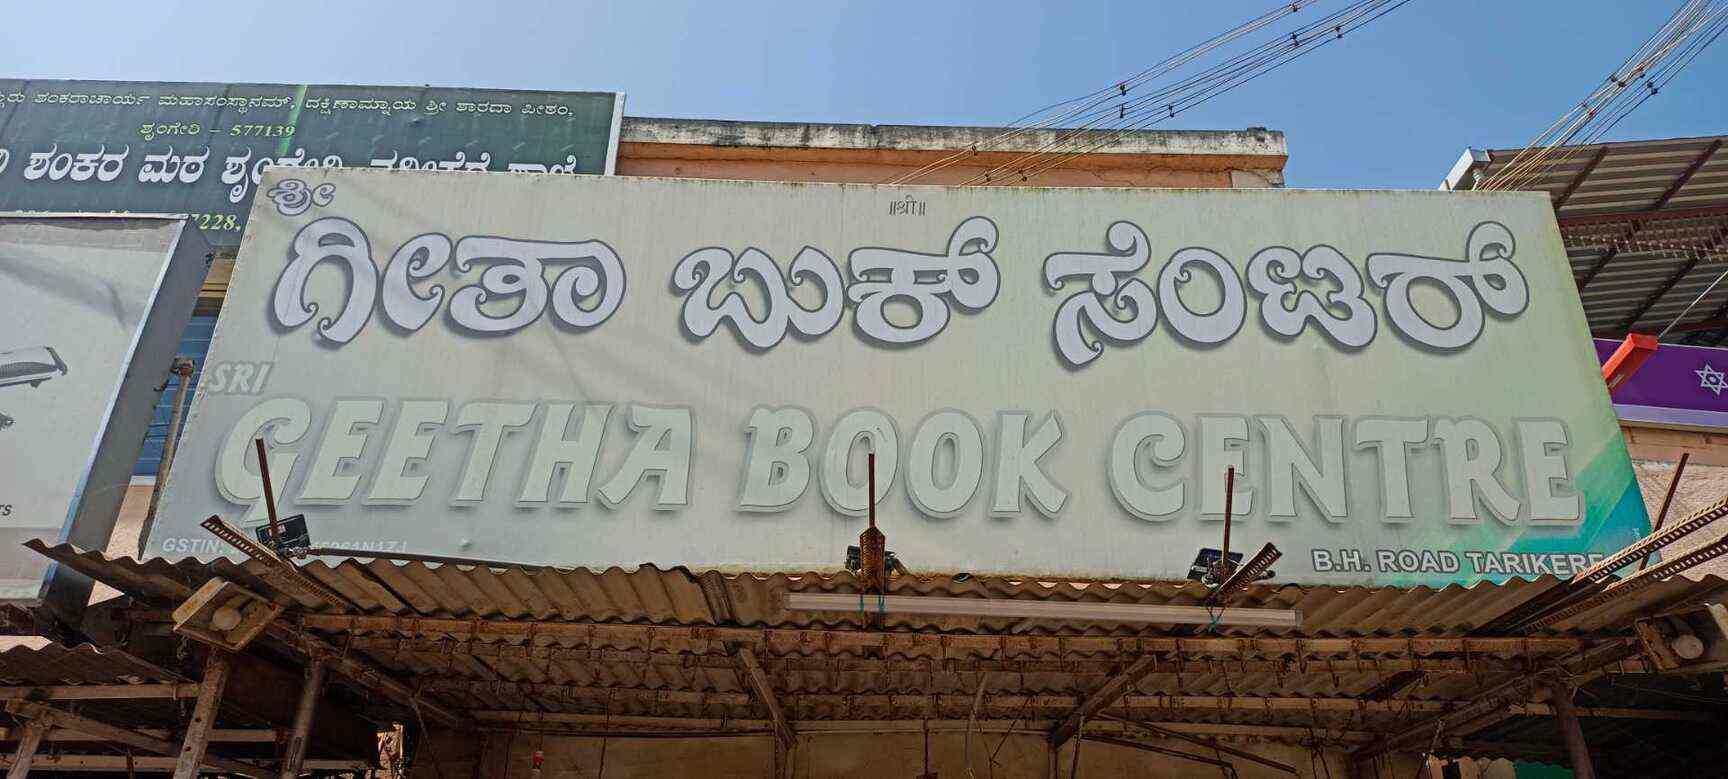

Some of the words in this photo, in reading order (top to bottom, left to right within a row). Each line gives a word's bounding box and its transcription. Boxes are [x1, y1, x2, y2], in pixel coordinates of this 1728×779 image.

[424, 99, 448, 115] ಶ್ರೀ
[456, 101, 513, 114] ಶಾರದಾ
[140, 120, 201, 141] ಶೃಂಗೇರಿ
[229, 124, 296, 138] 577139
[23, 143, 130, 182] ಶಂಕರ
[138, 145, 211, 183] ಮಠ
[267, 178, 336, 216] ಶ್ರೀ
[273, 216, 627, 346] ಗೀತಾ
[671, 215, 1000, 349] ಬುಕ್
[1043, 220, 1530, 366] ಸೆಂಟರ್
[207, 361, 273, 395] SRI
[214, 397, 694, 523] GEETHA
[737, 403, 1071, 518] BOOK
[1106, 411, 1585, 524] CENTRE
[1311, 547, 1370, 574] B.H.
[1375, 549, 1460, 575] ROAD
